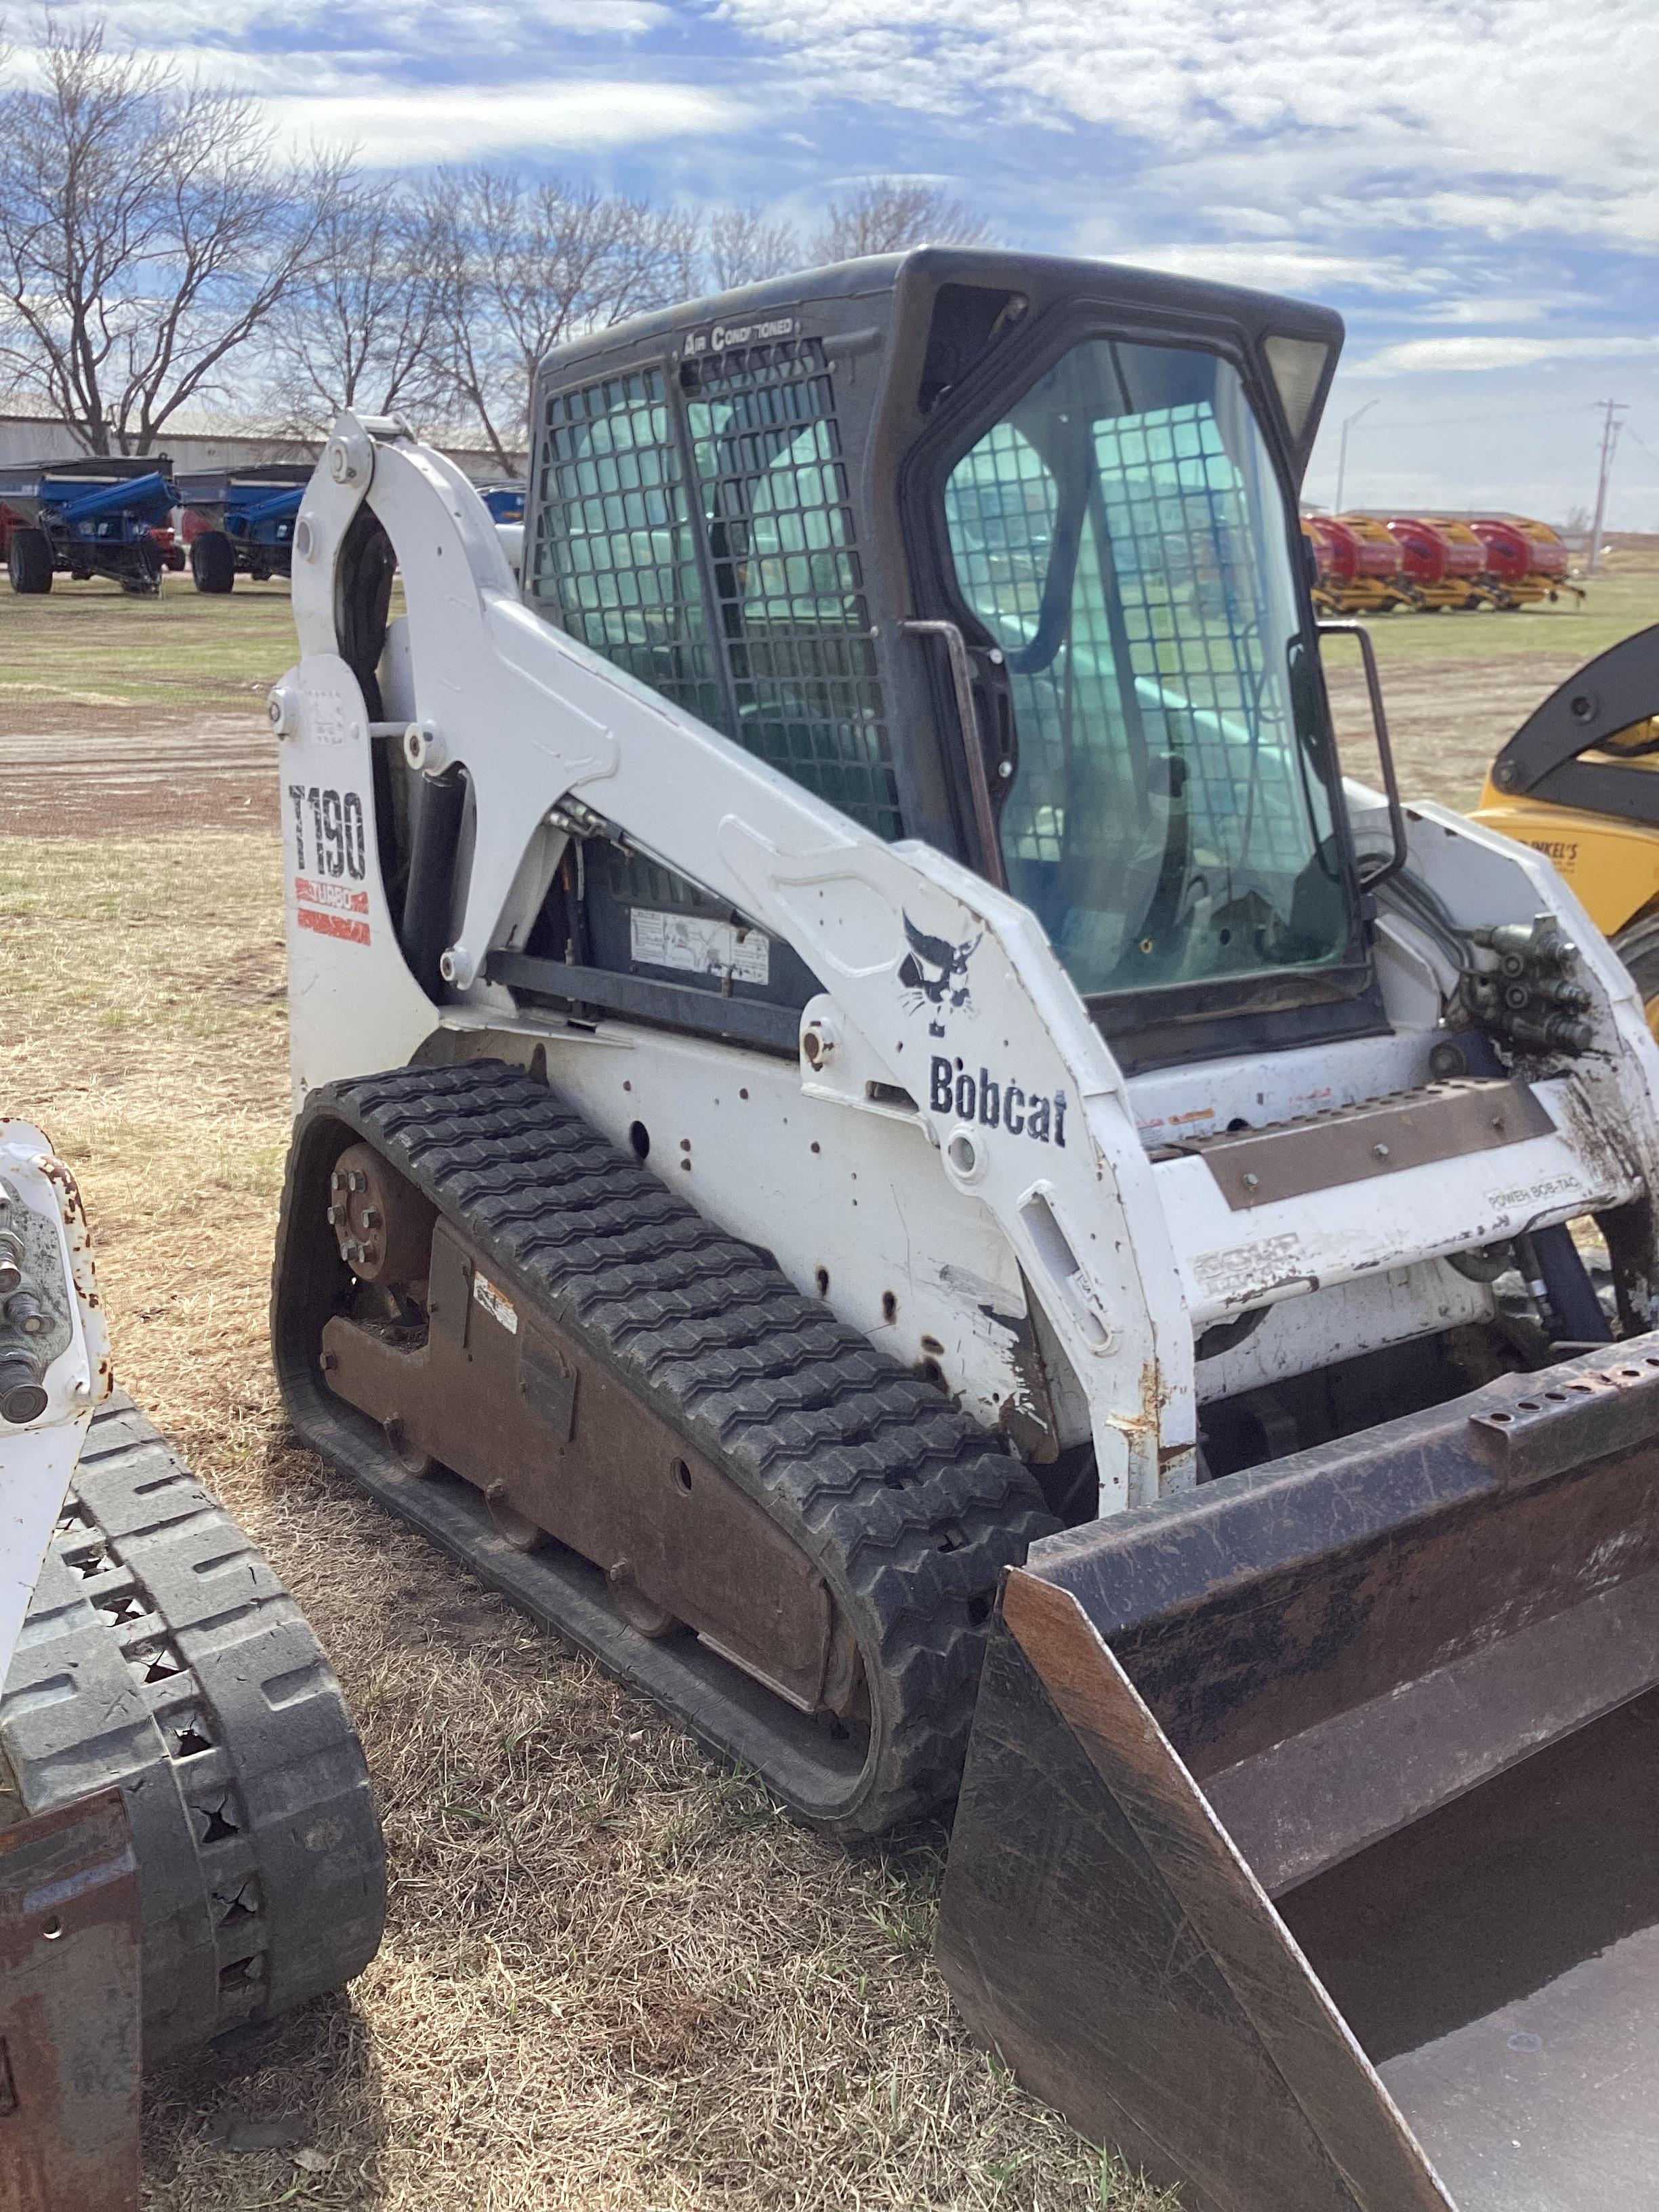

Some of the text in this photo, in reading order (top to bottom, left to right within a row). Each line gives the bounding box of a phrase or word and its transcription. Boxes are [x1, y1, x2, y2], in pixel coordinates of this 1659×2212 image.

[289, 785, 365, 880] T190
[308, 882, 352, 909] TURBO
[930, 1056, 1067, 1148] Bobcat
[1488, 1189, 1530, 1206] POWER
